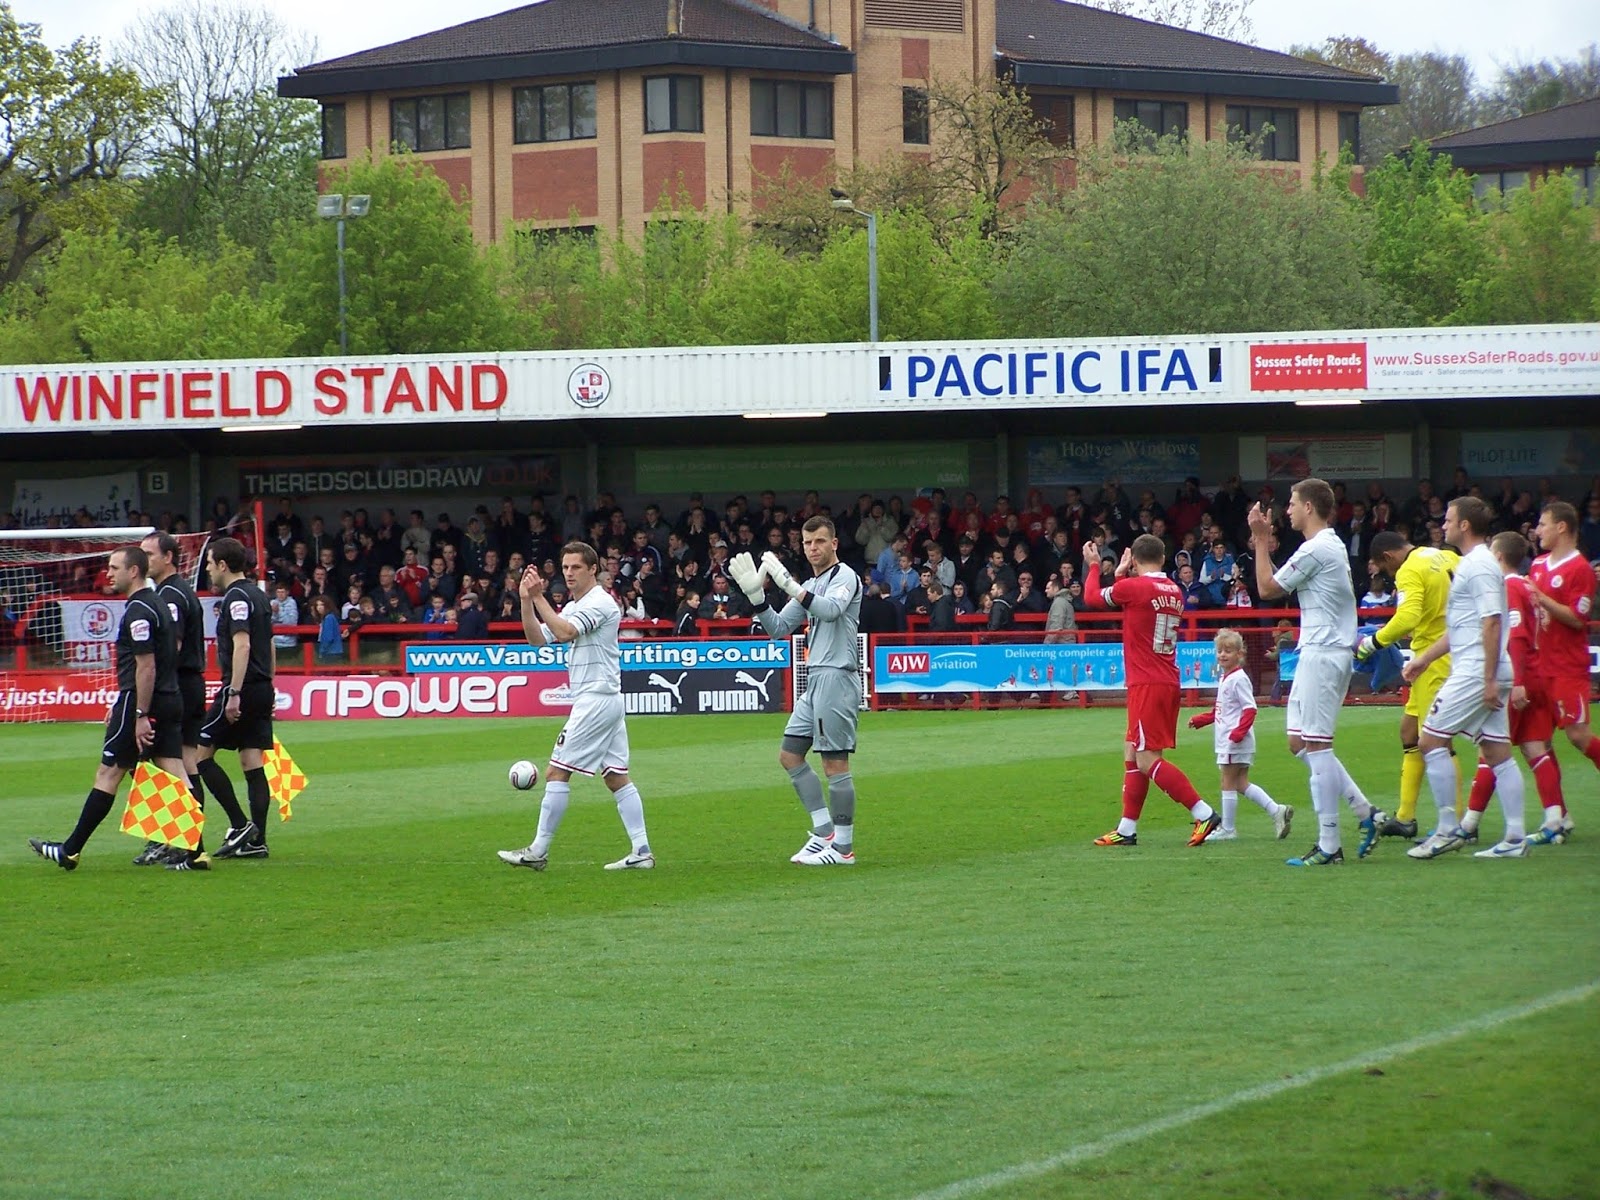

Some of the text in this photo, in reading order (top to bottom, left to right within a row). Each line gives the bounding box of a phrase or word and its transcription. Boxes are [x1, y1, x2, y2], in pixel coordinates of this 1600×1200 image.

[1254, 352, 1362, 368] Sussex Safer Roads
[1373, 350, 1600, 366] www.SussexSaferRoads.gov.u
[908, 349, 1198, 397] PACIFIC IFA
[1381, 369, 1400, 377] Safer
[15, 363, 508, 422] WINFIELD STAND
[1121, 440, 1198, 457] Windows
[153, 475, 164, 490] B
[1153, 613, 1182, 655] 15
[1005, 648, 1057, 662] Delivering
[1059, 647, 1105, 661] complete
[890, 655, 978, 673] AJW aviation
[698, 689, 760, 712] PUMA
